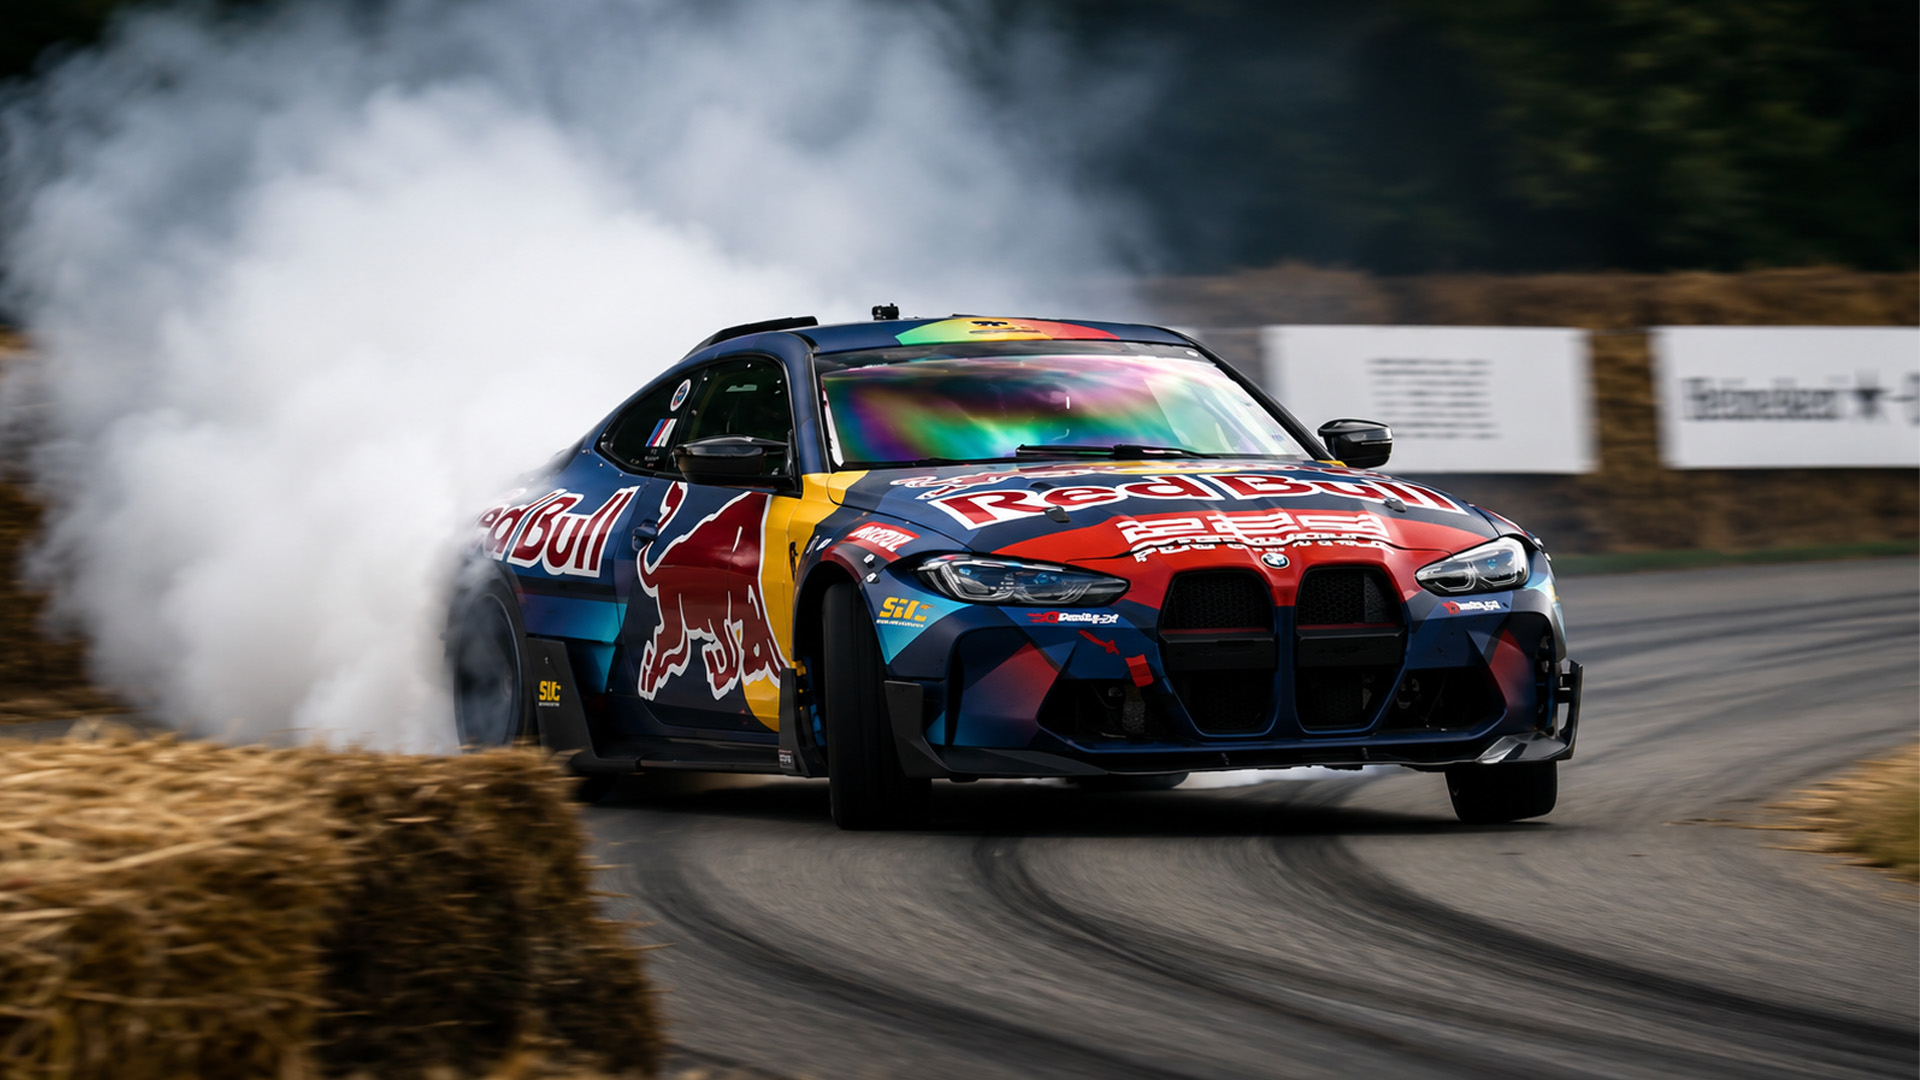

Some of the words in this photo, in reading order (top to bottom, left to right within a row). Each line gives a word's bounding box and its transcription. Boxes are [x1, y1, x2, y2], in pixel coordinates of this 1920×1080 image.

[506, 485, 640, 578] Bull
[927, 473, 1225, 530] Red
[1196, 473, 1472, 515] Bull
